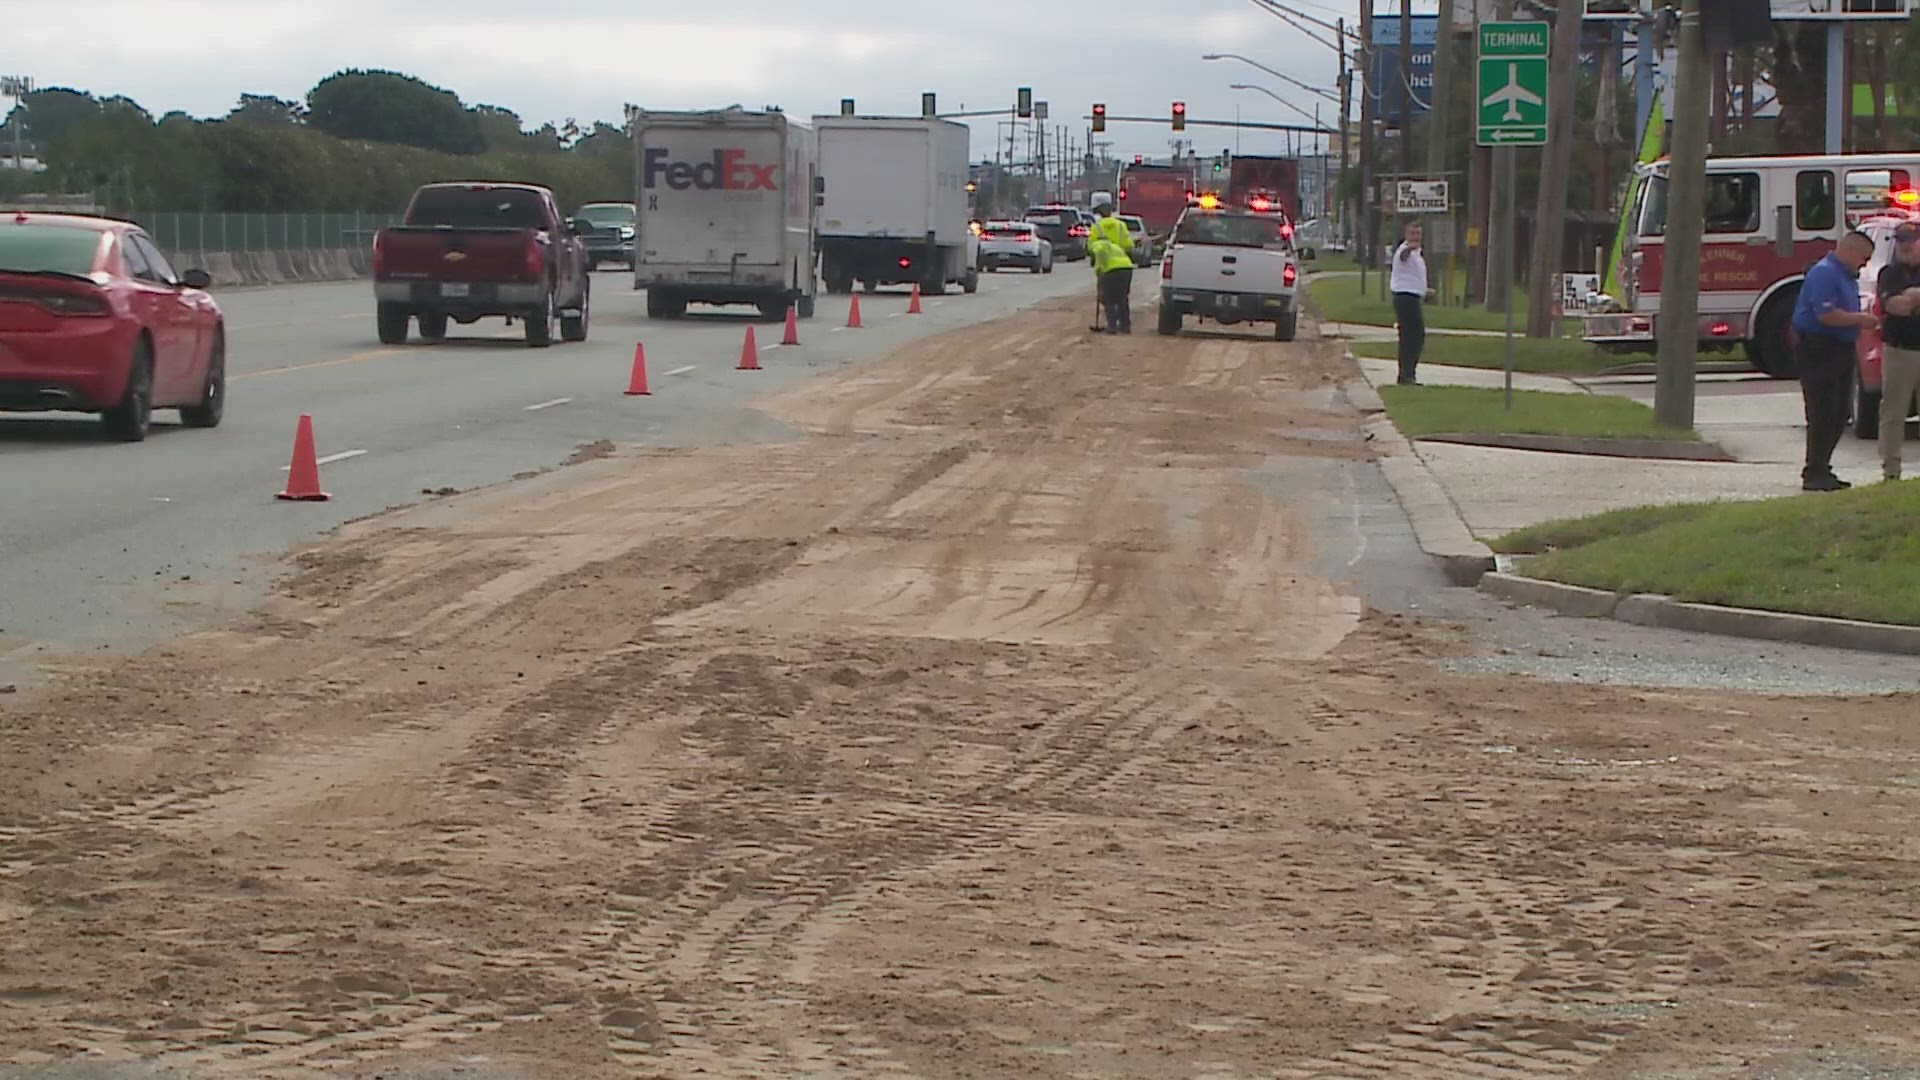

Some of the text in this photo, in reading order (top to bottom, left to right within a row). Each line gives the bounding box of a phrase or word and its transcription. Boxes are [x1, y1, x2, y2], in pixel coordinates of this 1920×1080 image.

[1484, 32, 1544, 47] TERMINAL
[643, 147, 778, 191] FedEx
[1714, 271, 1759, 281] RESCUE
